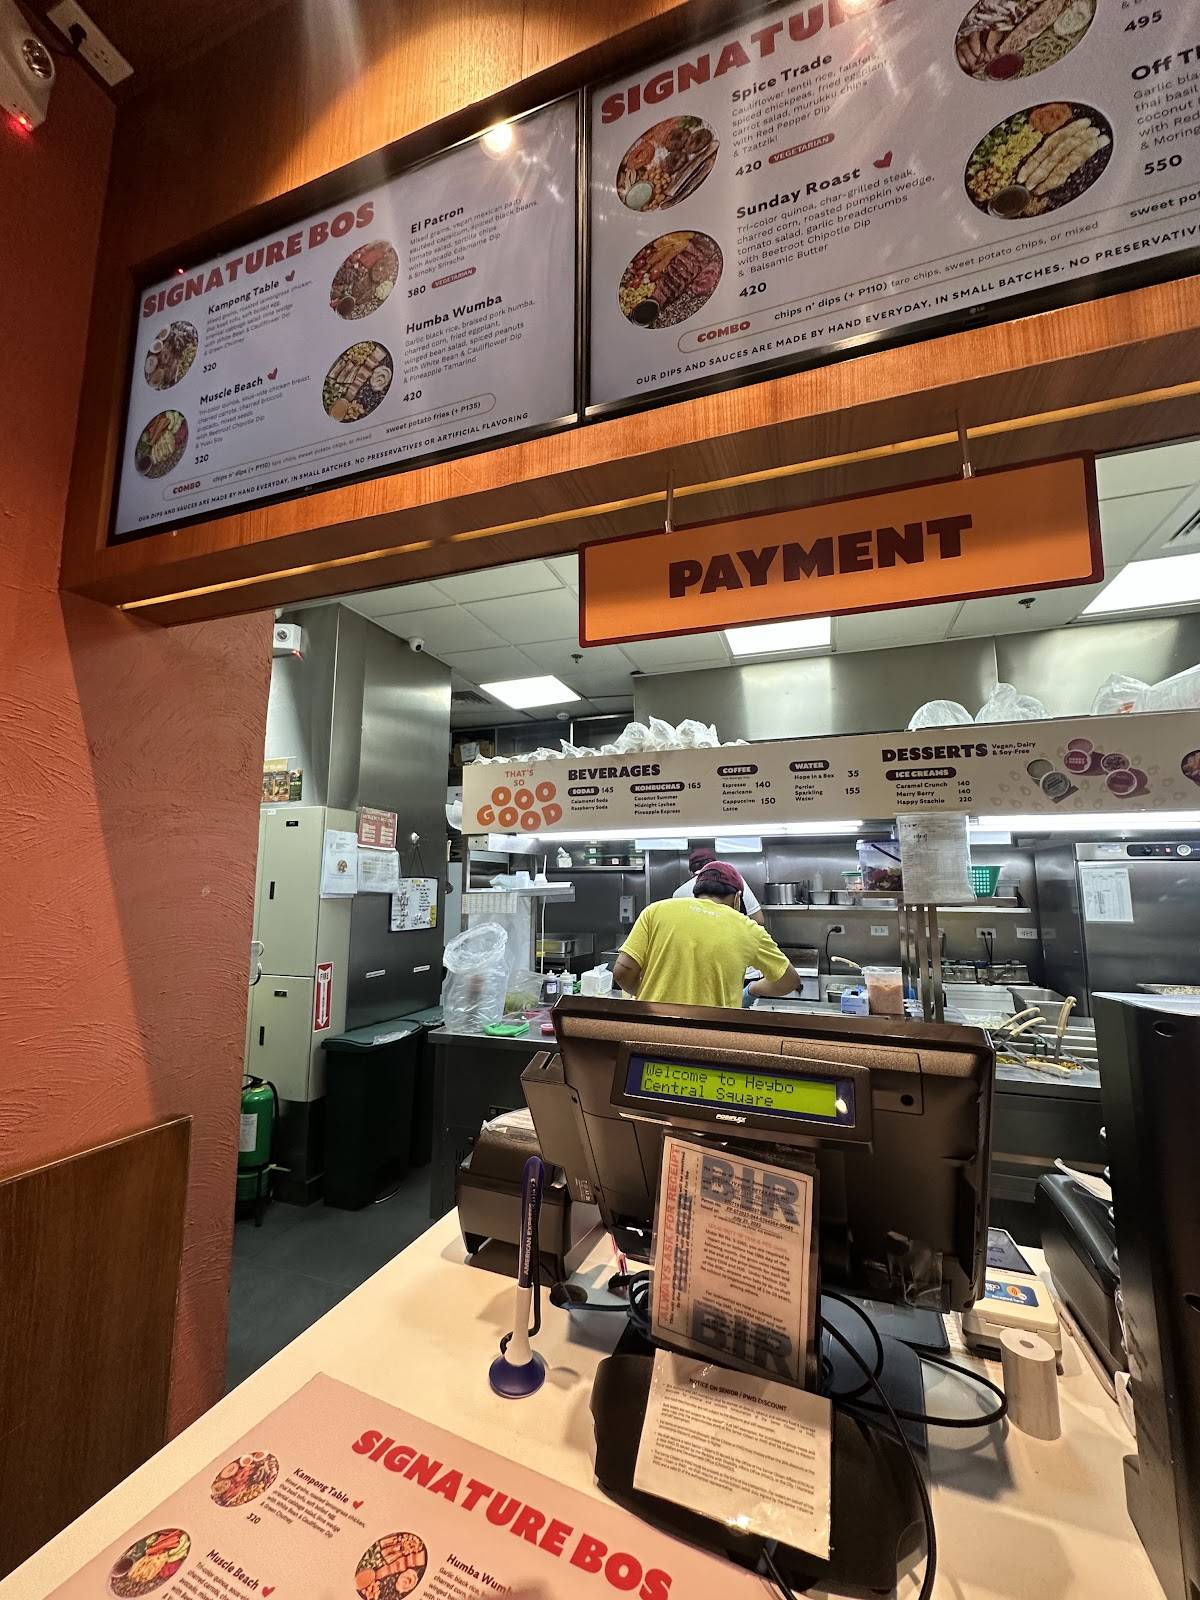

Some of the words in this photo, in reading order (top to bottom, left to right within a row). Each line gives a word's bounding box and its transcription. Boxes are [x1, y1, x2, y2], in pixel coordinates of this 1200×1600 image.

[1124, 9, 1162, 32] 495
[732, 77, 777, 102] Spice
[781, 55, 832, 82] Trade
[1132, 55, 1172, 80] Off
[1135, 100, 1161, 112] thai
[1166, 84, 1198, 101] basil
[733, 134, 753, 146] with
[757, 126, 774, 139] Red
[777, 113, 810, 131] Pepper
[815, 105, 830, 116] Dip
[1137, 101, 1193, 124] coconut
[1139, 122, 1168, 136] with
[1174, 112, 1199, 126] Red
[733, 122, 760, 137] carrot
[735, 160, 762, 177] 420
[774, 136, 829, 161] VEGETARIAN
[1144, 154, 1183, 175] 550
[736, 190, 800, 219] Sunday
[806, 168, 861, 195] Roast
[737, 215, 777, 234] Tri-color
[820, 180, 880, 206] char-grilled
[411, 222, 421, 233] El
[424, 206, 464, 228] Patron
[737, 227, 773, 245] charred
[804, 205, 842, 223] roasted
[846, 188, 892, 210] pumpkin
[896, 175, 935, 194] wedge,
[1130, 199, 1174, 218] sweet
[738, 240, 772, 255] tomato
[806, 218, 834, 235] garlic
[837, 194, 908, 223] breadcrumbs
[738, 254, 759, 267] with
[762, 240, 805, 259] Beetroot
[808, 225, 850, 246] Chipotle
[854, 219, 871, 231] Dip
[892, 277, 910, 288] taro
[944, 258, 974, 272] sweet
[978, 248, 1012, 265] potato
[1050, 232, 1062, 241] or
[1065, 220, 1099, 238] mixed
[143, 231, 303, 319] SIGNATURE
[309, 202, 375, 250] BOS
[750, 254, 794, 274] Balsamic
[797, 243, 829, 259] Butter
[208, 291, 251, 315] Kampong
[253, 281, 279, 296] Table
[408, 285, 426, 298] 380
[739, 282, 767, 298] 420
[406, 314, 449, 334] Humba
[452, 296, 502, 318] Wumba
[636, 372, 658, 385] OUR
[660, 366, 682, 380] DIPS
[684, 360, 706, 372] AND
[709, 349, 749, 366] SAUCES
[752, 342, 773, 355] ARE
[776, 332, 807, 348] MADE
[810, 327, 824, 338] BY
[828, 318, 862, 334] HAND
[866, 300, 931, 324] EVERYDAY,
[935, 293, 948, 305] IN
[952, 281, 995, 300] SMALL
[1069, 256, 1090, 268] NO
[1096, 225, 1200, 261] PRESERVATIV
[697, 320, 751, 344] COMBO
[774, 307, 802, 320] chips
[819, 295, 841, 309] dips
[858, 282, 888, 297] P110)
[203, 363, 217, 373] 320
[200, 389, 232, 405] Muscle
[234, 376, 263, 393] Beach
[402, 390, 422, 402] 420
[194, 454, 209, 464] 320
[198, 498, 210, 507] ARE
[212, 494, 228, 504] MADE
[228, 492, 238, 500] BY
[238, 486, 256, 497] HAND
[290, 474, 298, 482] IN
[299, 469, 320, 480] SMALL
[368, 440, 422, 461] PRESERVATIVES
[424, 437, 436, 446] OR
[437, 424, 480, 442] ARTIFICIAL
[482, 412, 529, 430] FLAVORING
[172, 480, 201, 495] COMBO
[668, 514, 973, 599] PAYMENT
[882, 743, 988, 763] DESSERTS
[1016, 740, 1036, 748] Dairy
[504, 769, 534, 778] THAT'S
[568, 764, 662, 781] BEVERAGES
[722, 766, 752, 774] COFFEE
[794, 762, 824, 770] WATER
[847, 770, 860, 778] 35
[910, 769, 950, 778] CREAMS
[513, 779, 525, 787] SO
[634, 783, 681, 792] KOMBUCHAS
[755, 780, 771, 788] 140
[844, 786, 860, 795] 155
[476, 802, 562, 831] GOOD
[644, 1078, 704, 1098] Central
[716, 1087, 774, 1107] Square
[645, 1064, 708, 1084] Welcome
[718, 1071, 736, 1086] to
[745, 1075, 794, 1094] Heybo
[701, 1155, 800, 1226] BIR
[665, 1209, 676, 1235] FOR
[665, 1237, 674, 1262] ASK
[692, 1299, 793, 1379] BIR
[293, 1467, 328, 1492] Kampong
[328, 1486, 349, 1503] Table
[351, 1430, 574, 1557] SIGNATURE
[569, 1533, 673, 1600] BOS
[206, 1549, 235, 1573] Muscle
[233, 1567, 259, 1591] Beach
[447, 1554, 480, 1579] Humba
